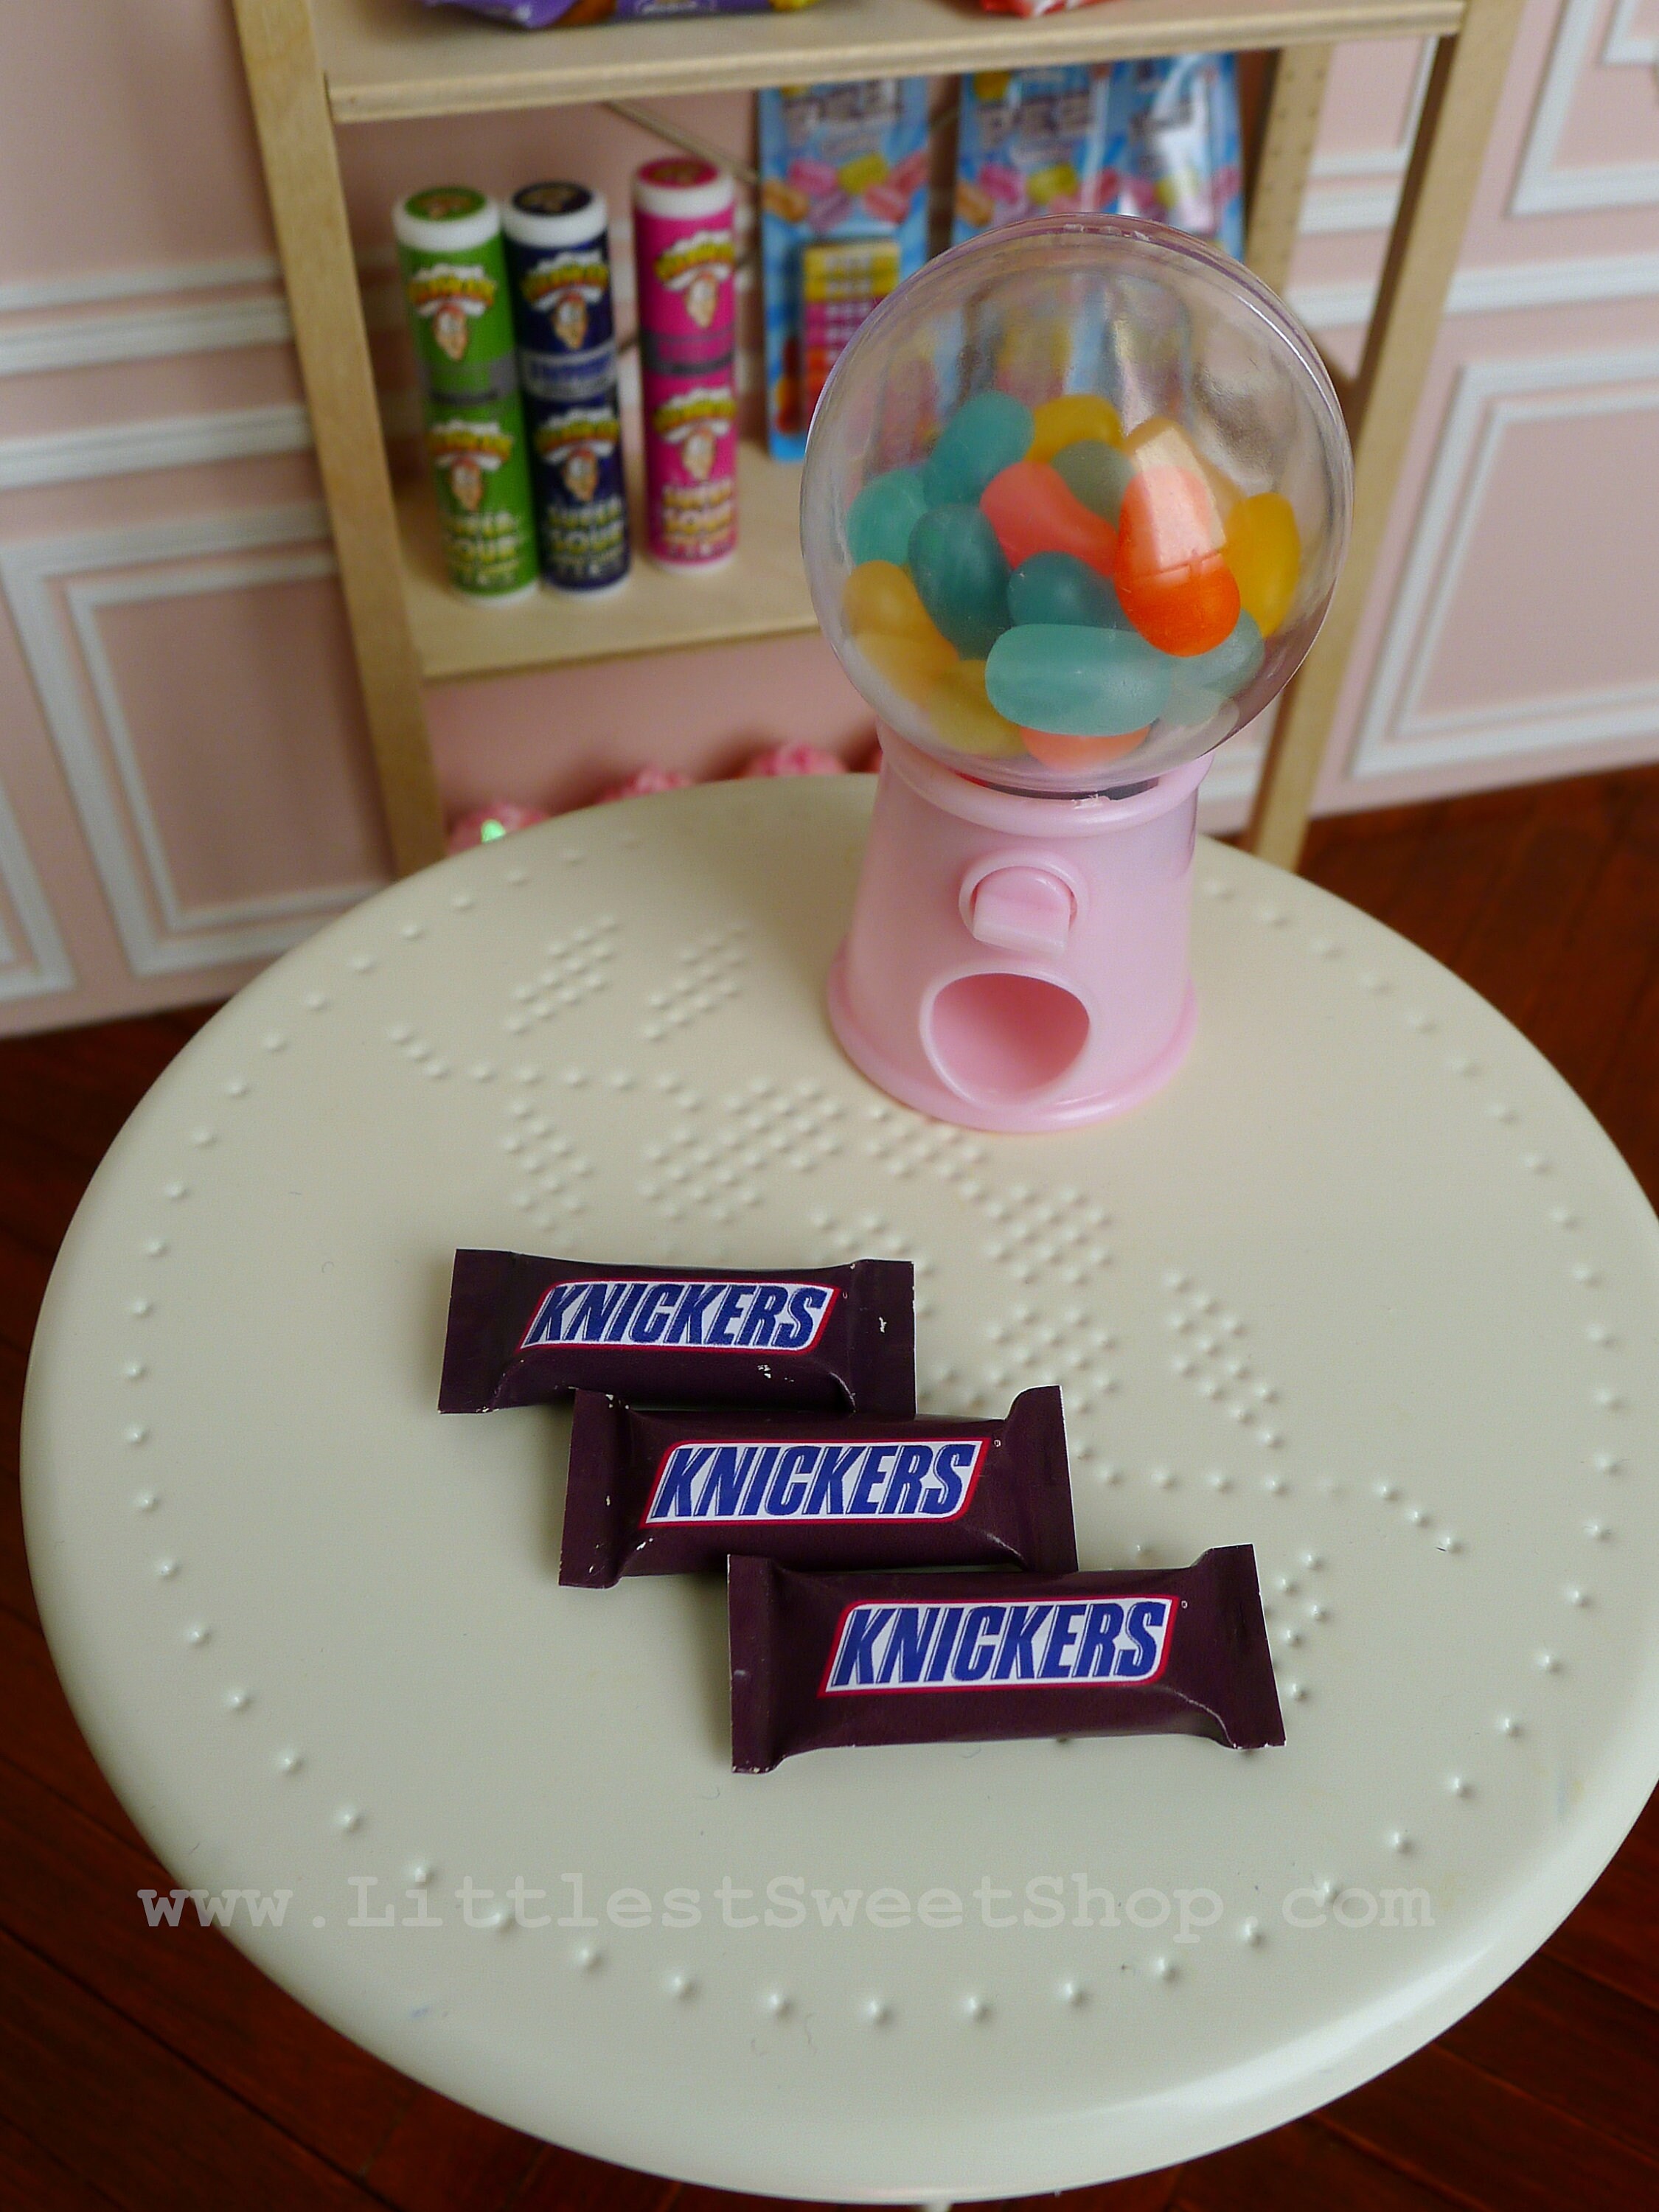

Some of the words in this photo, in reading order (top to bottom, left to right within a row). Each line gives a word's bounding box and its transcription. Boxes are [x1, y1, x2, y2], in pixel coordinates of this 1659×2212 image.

[524, 1282, 826, 1350] KNICKERS
[651, 1443, 975, 1518] KNICKERS
[831, 1600, 1164, 1688] KNICKERS
